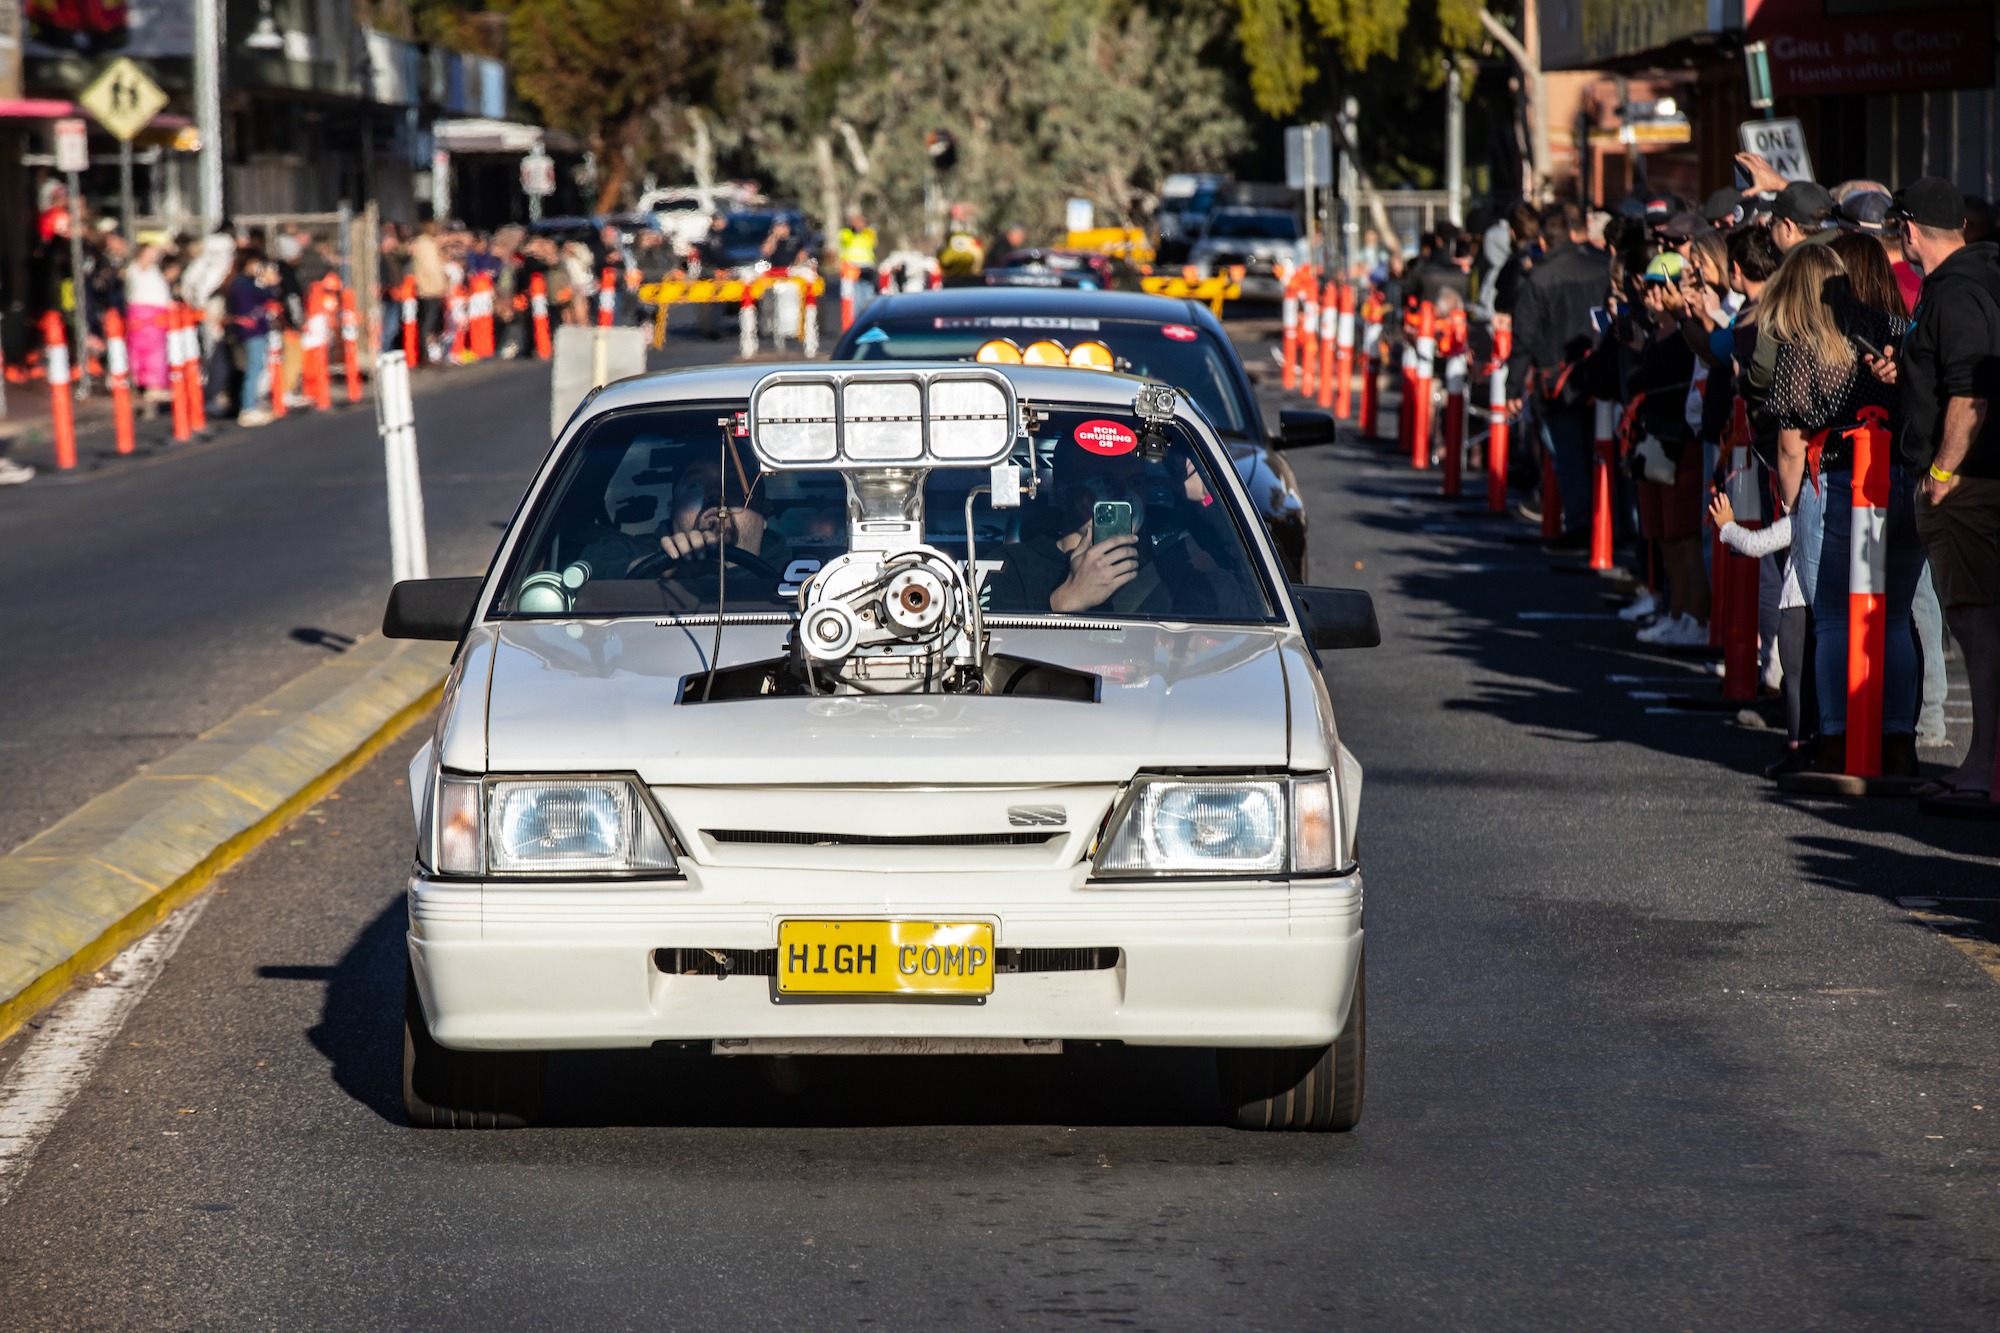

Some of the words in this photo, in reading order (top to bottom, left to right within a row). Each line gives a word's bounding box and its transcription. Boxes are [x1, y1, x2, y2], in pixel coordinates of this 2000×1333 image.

[1789, 59, 1903, 83] Handcrafted
[1907, 58, 1952, 76] Food
[1756, 128, 1796, 151] ONE
[1079, 432, 1132, 443] CRUISING
[1093, 426, 1117, 435] RCN
[788, 943, 877, 975] HIGH
[899, 944, 987, 976] COMP
